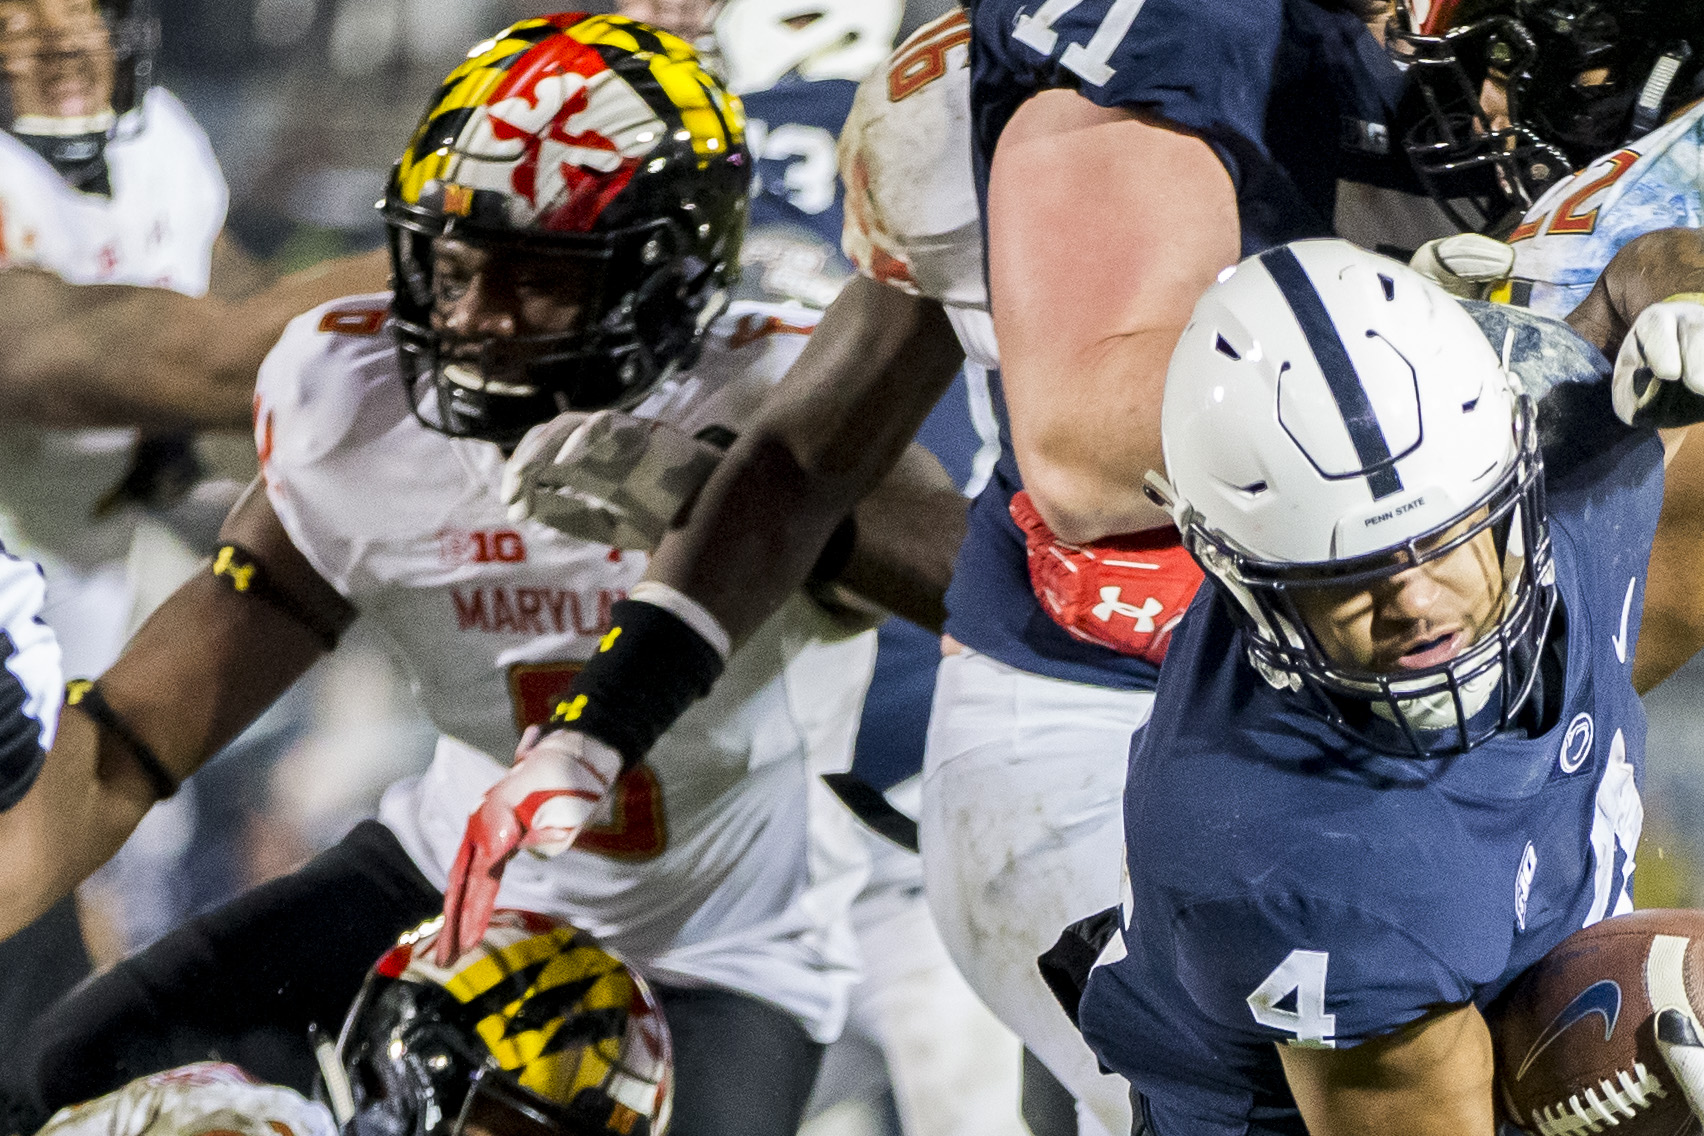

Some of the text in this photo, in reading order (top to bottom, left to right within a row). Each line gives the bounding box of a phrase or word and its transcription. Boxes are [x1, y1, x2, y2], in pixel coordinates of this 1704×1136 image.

[1364, 497, 1425, 527] PENN STATE
[1246, 948, 1336, 1049] 4
